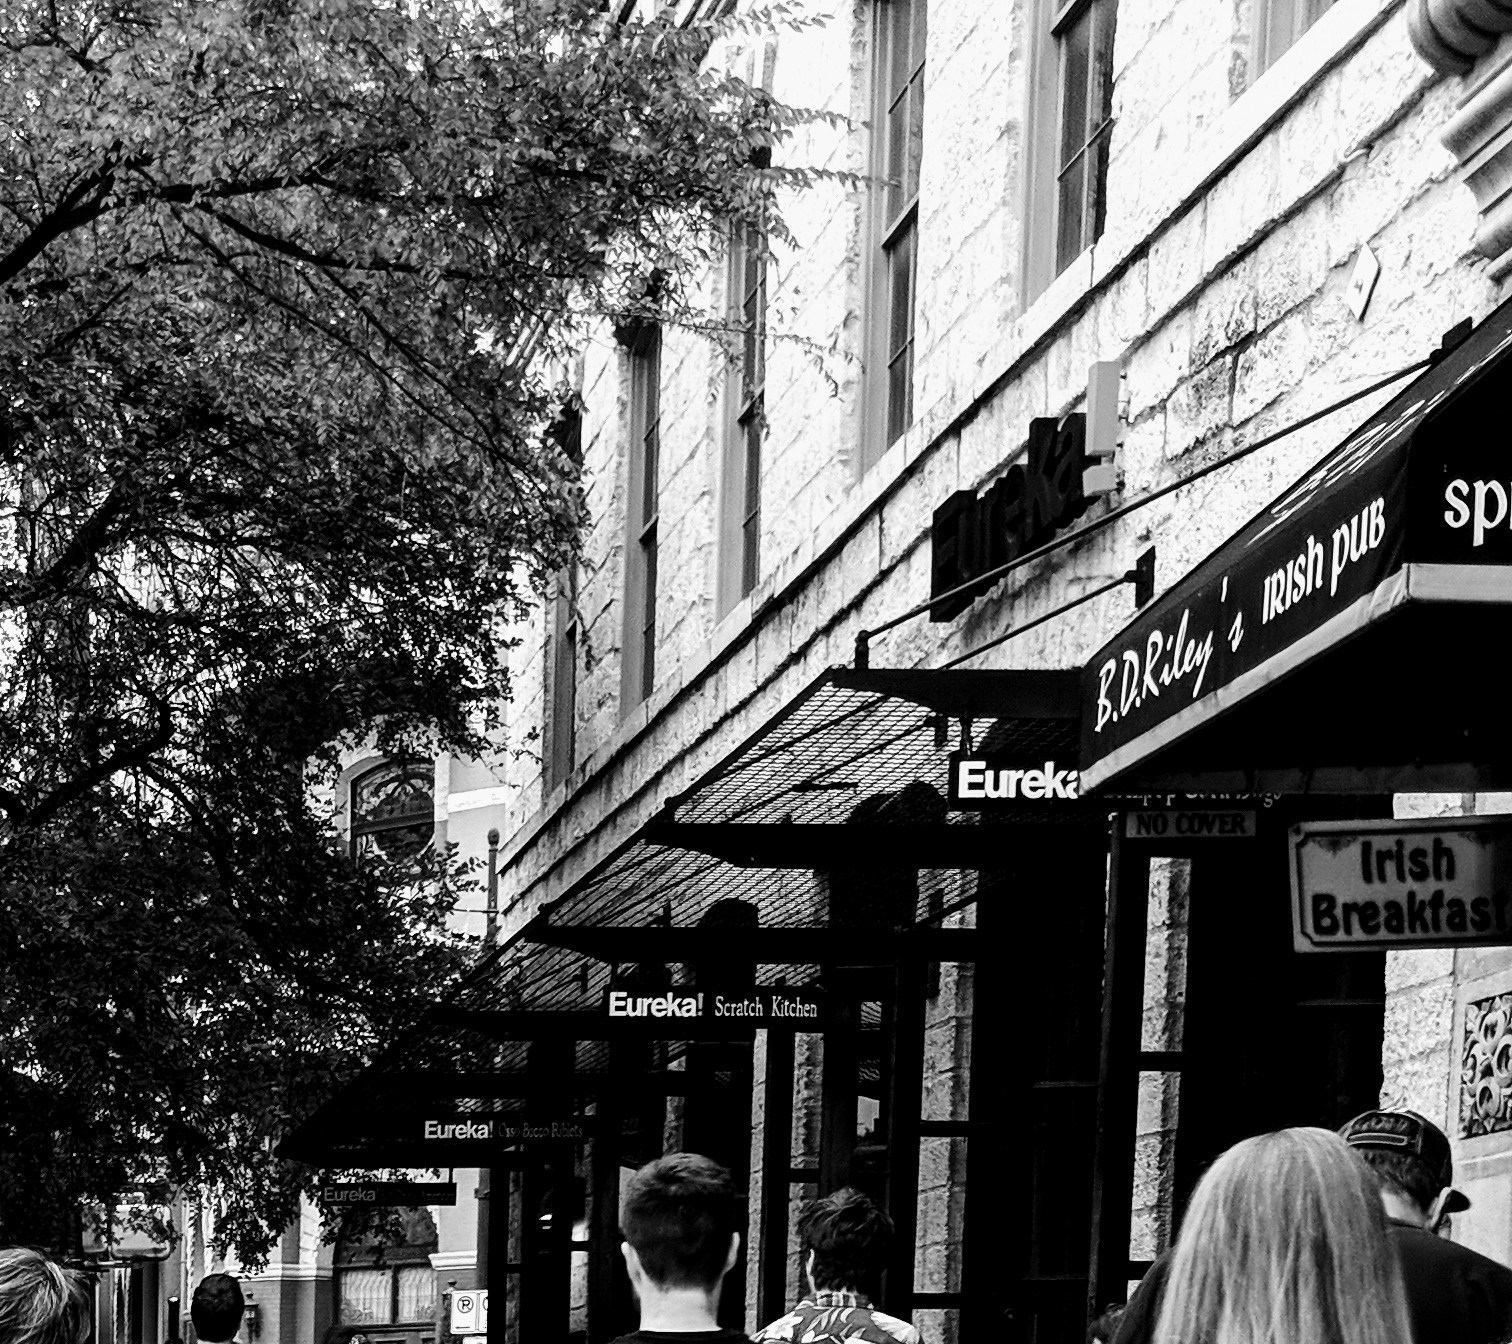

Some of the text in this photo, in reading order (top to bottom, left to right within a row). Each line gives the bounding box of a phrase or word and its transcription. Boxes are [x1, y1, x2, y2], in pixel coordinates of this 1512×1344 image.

[1444, 479, 1512, 548] sp
[1136, 812, 1246, 835] NO COVER
[1361, 837, 1455, 884] Irish
[1312, 888, 1510, 936] Breakfast
[608, 991, 818, 1019] Eureka! Scratch Kitchen
[424, 1120, 494, 1140] Eureka!
